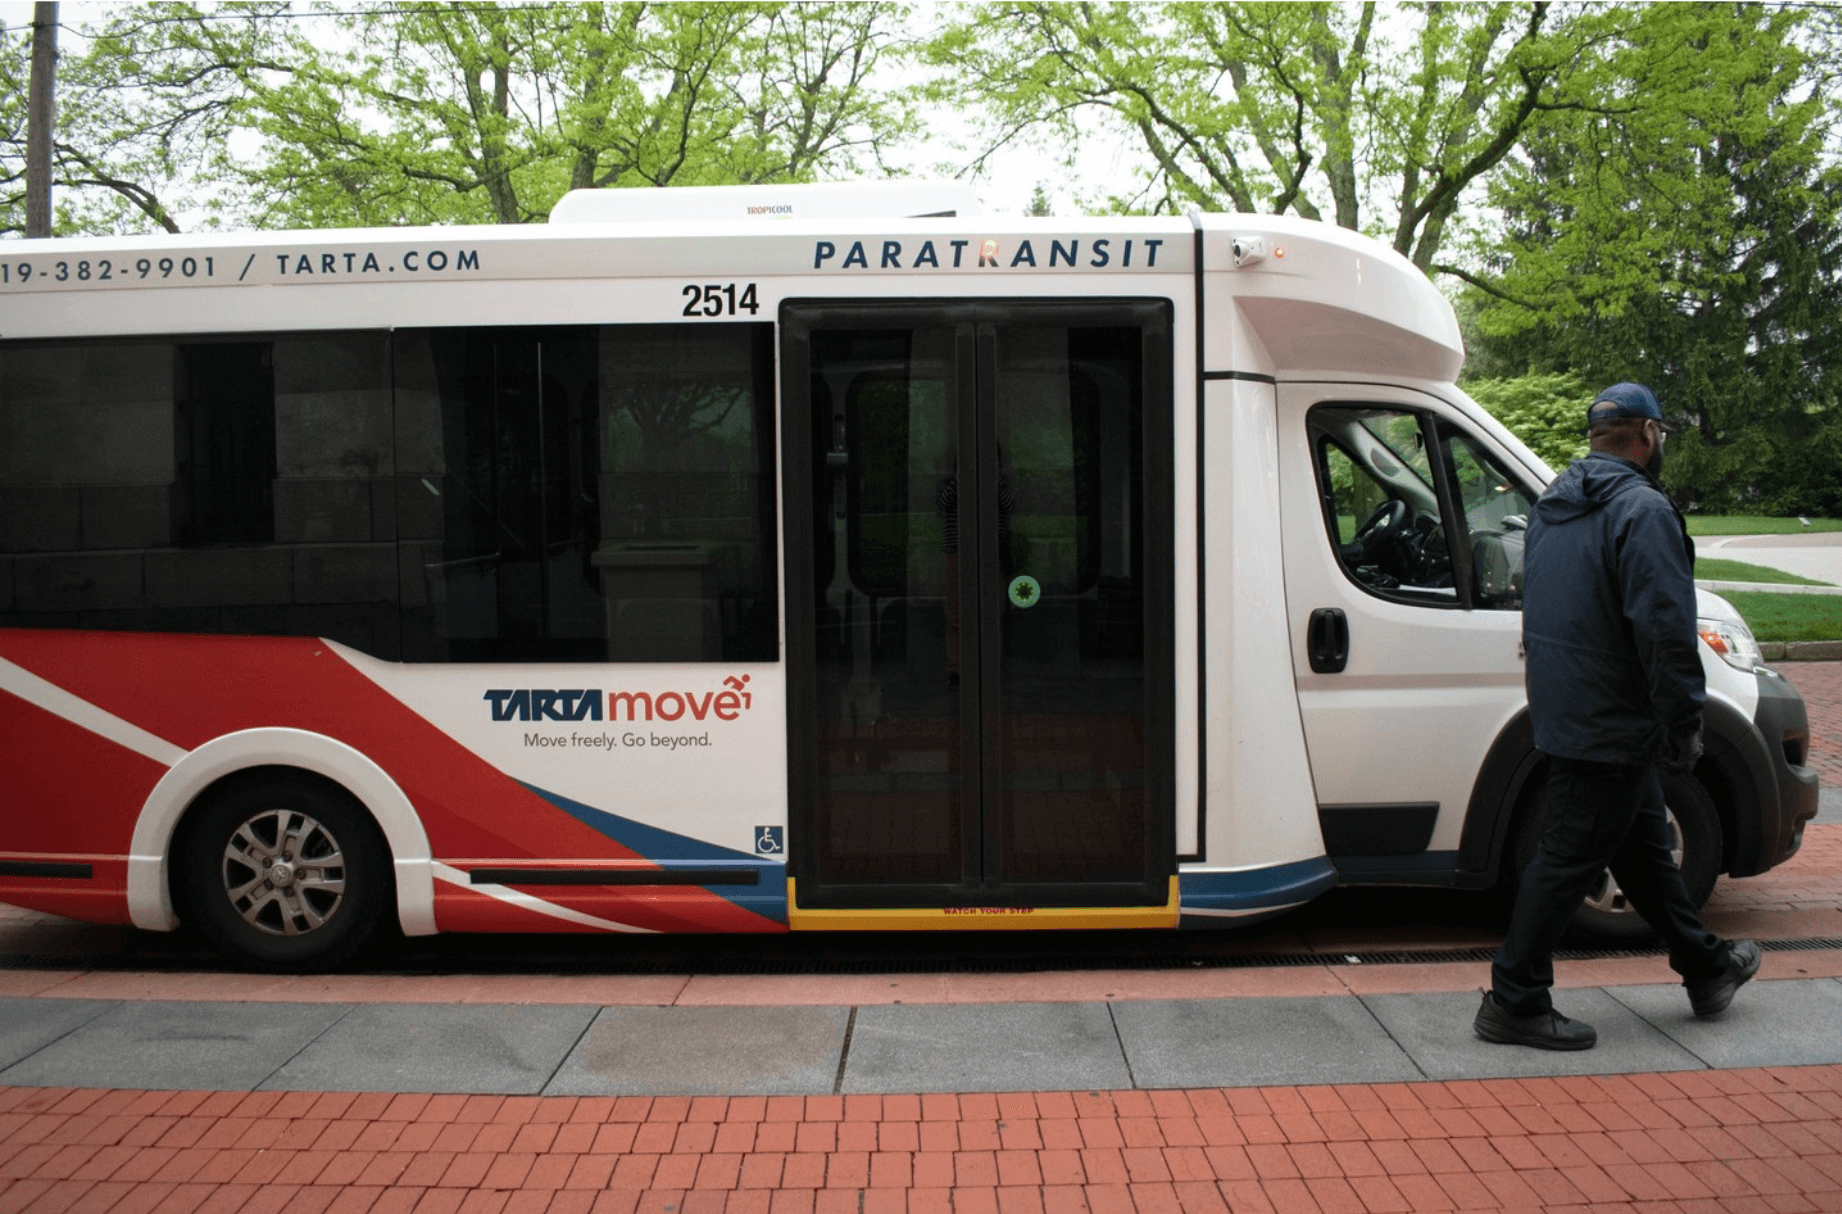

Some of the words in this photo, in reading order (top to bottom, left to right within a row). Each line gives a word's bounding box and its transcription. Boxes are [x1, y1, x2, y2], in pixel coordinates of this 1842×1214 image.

[747, 204, 793, 214] TROPICOOL
[276, 250, 480, 275] TARTA.COM
[682, 283, 758, 316] 2514
[524, 732, 567, 748] Move
[571, 732, 617, 751] freely.
[622, 732, 646, 748] Go
[650, 732, 712, 751] beyond.
[943, 907, 977, 915] WATCH
[980, 907, 1005, 915] YOUR
[1009, 907, 1034, 915] STEP
